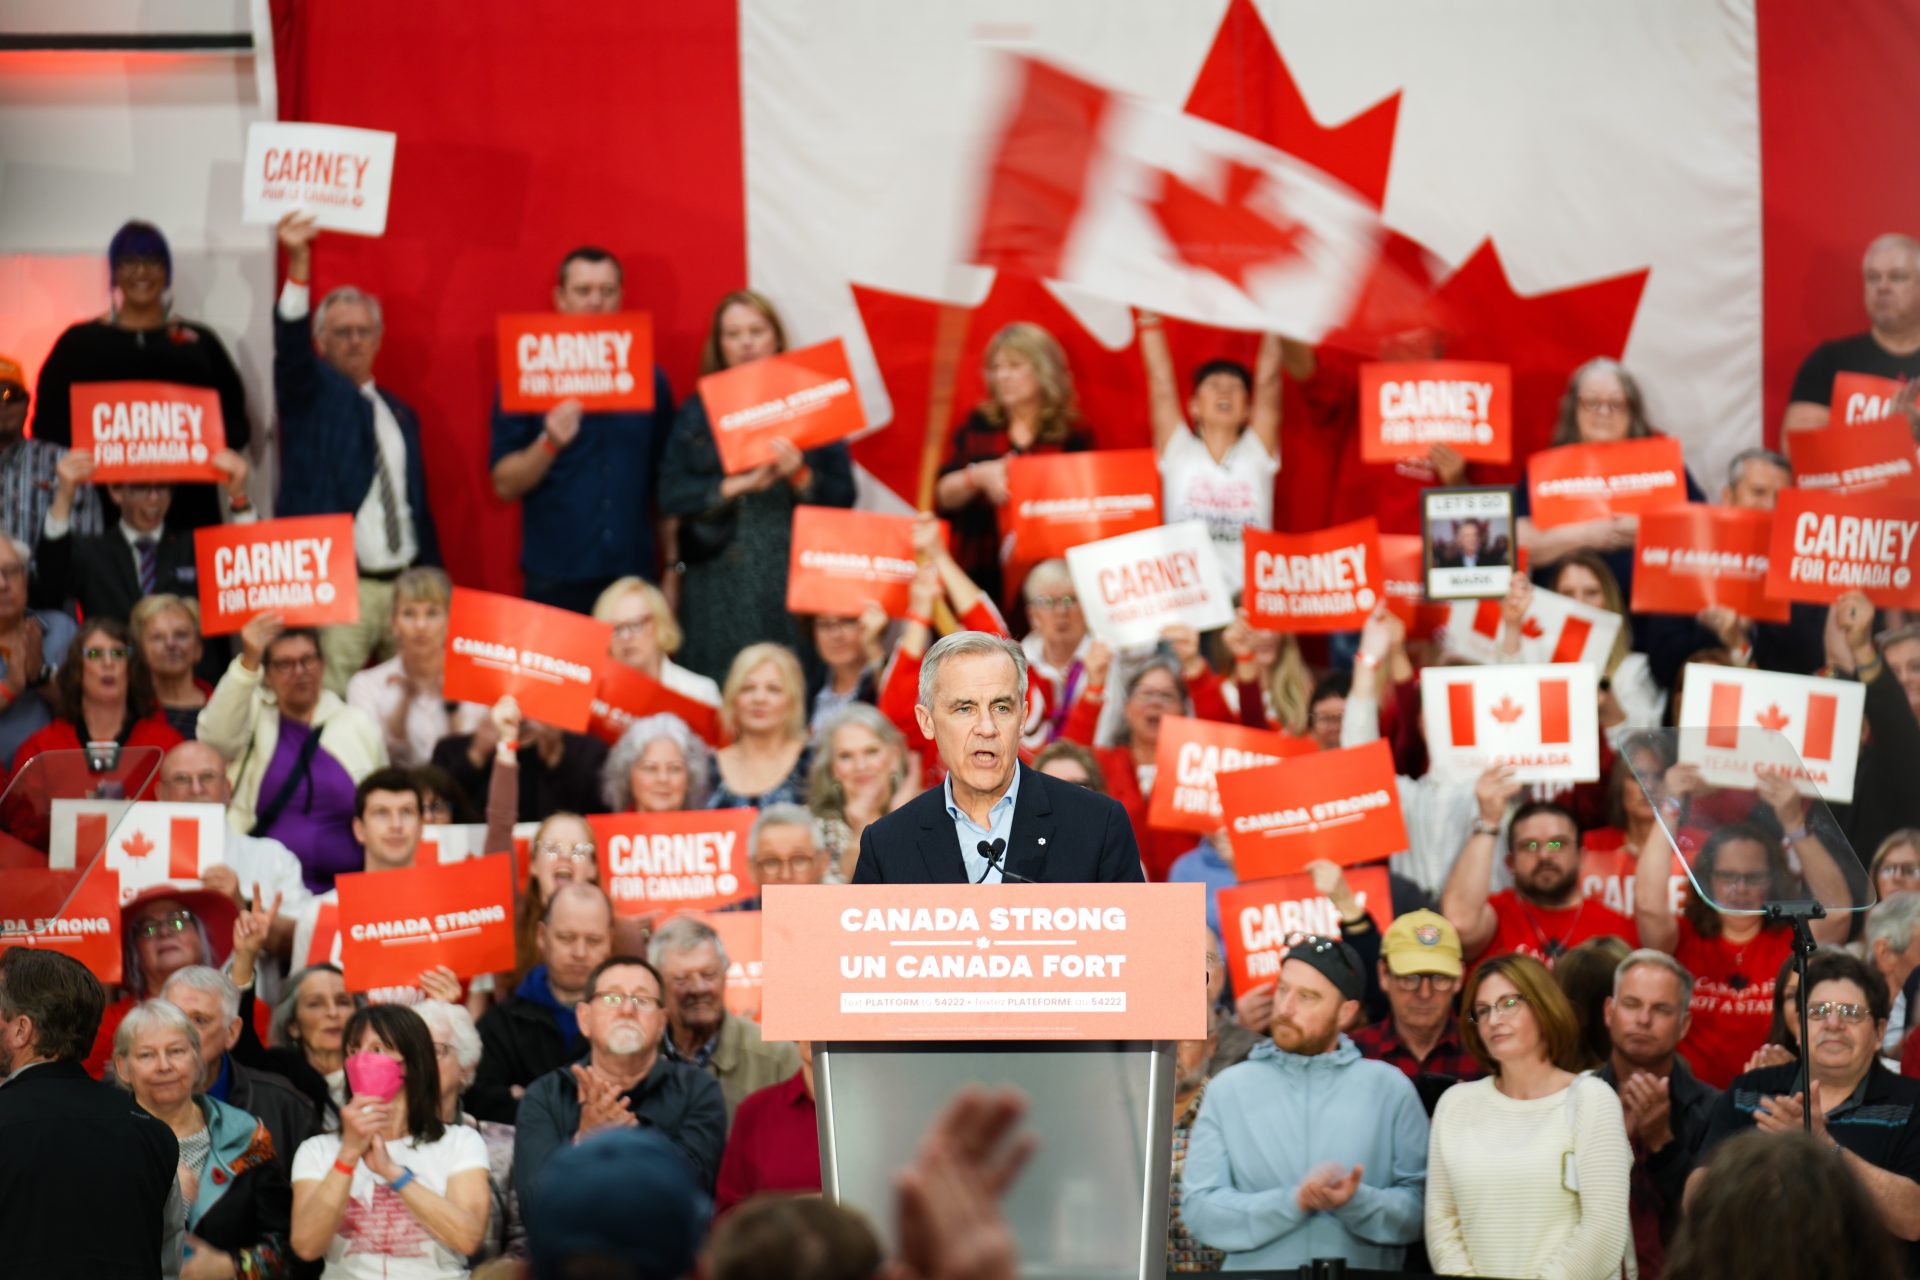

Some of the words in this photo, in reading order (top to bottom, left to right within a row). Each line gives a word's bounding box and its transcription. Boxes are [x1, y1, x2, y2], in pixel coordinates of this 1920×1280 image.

[264, 147, 370, 190] CARNEY
[517, 330, 633, 371] CARNEY
[519, 372, 549, 397] FOR
[552, 371, 614, 396] CANADA
[1379, 380, 1493, 420] CARNEY
[93, 402, 203, 441] CARNEY
[1381, 420, 1412, 445] FOR
[1414, 419, 1474, 444] CANADA
[94, 441, 124, 467] FOR
[127, 441, 189, 465] CANADA
[1481, 494, 1504, 509] GO
[1793, 511, 1920, 564] CARNEY
[214, 537, 333, 589] CARNEY
[1254, 542, 1368, 593] CARNEY
[1671, 548, 1743, 570] CANADA
[1790, 556, 1825, 585] FOR
[1827, 560, 1892, 589] CANADA
[1099, 550, 1202, 606] CARNEY
[217, 588, 247, 616] FOR
[248, 582, 315, 611] CANADA
[1255, 591, 1287, 615] FOR
[1289, 590, 1357, 616] CANADA
[452, 636, 518, 663] CANADA
[520, 650, 593, 684] STRONG
[1703, 754, 1749, 773] TEAM
[1752, 760, 1830, 785] CANADA
[1173, 785, 1208, 814] FOR
[1233, 806, 1311, 834] CANADA
[1312, 789, 1392, 821] STRONG
[608, 830, 737, 876] CARNEY
[609, 876, 644, 902] FOR
[646, 874, 717, 900] CANADA
[34, 916, 111, 935] STRONG
[351, 915, 433, 941] CANADA
[434, 904, 505, 931] STRONG
[840, 907, 980, 931] CANADA
[989, 907, 1127, 931] STRONG
[840, 955, 886, 979] UN
[895, 955, 1033, 979] CANADA
[1042, 954, 1127, 978] FORT
[1245, 949, 1282, 979] FOR
[844, 998, 863, 1007] Text
[865, 998, 919, 1008] PLATFORM
[922, 998, 932, 1007] to
[934, 998, 965, 1007] 54222
[975, 998, 1005, 1007] Textez
[1007, 997, 1073, 1007] PLATEFORME
[1091, 997, 1122, 1007] 54222
[1720, 1000, 1734, 1015] A
